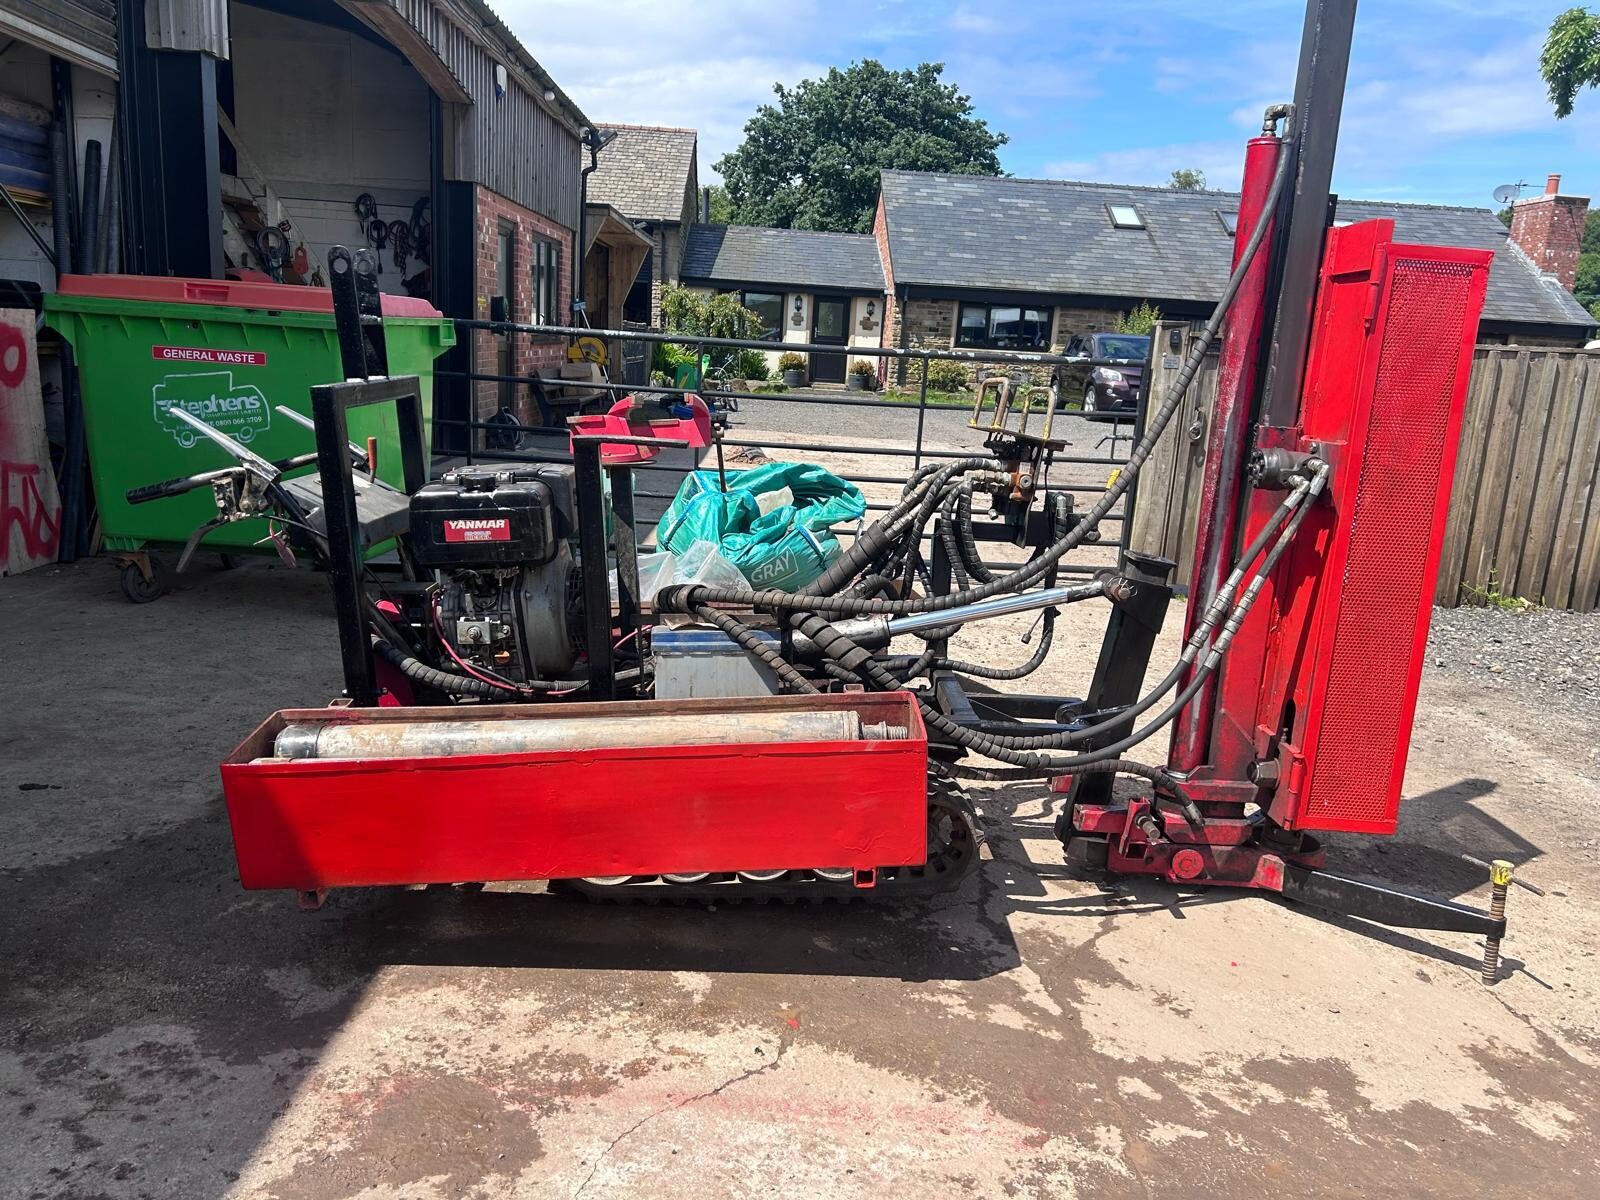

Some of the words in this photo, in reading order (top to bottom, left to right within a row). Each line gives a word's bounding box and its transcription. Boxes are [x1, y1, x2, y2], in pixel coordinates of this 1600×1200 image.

[163, 349, 214, 361] GENERAL
[217, 352, 255, 364] WASTE
[449, 519, 505, 529] YANMAR
[751, 551, 790, 582] GRAY
